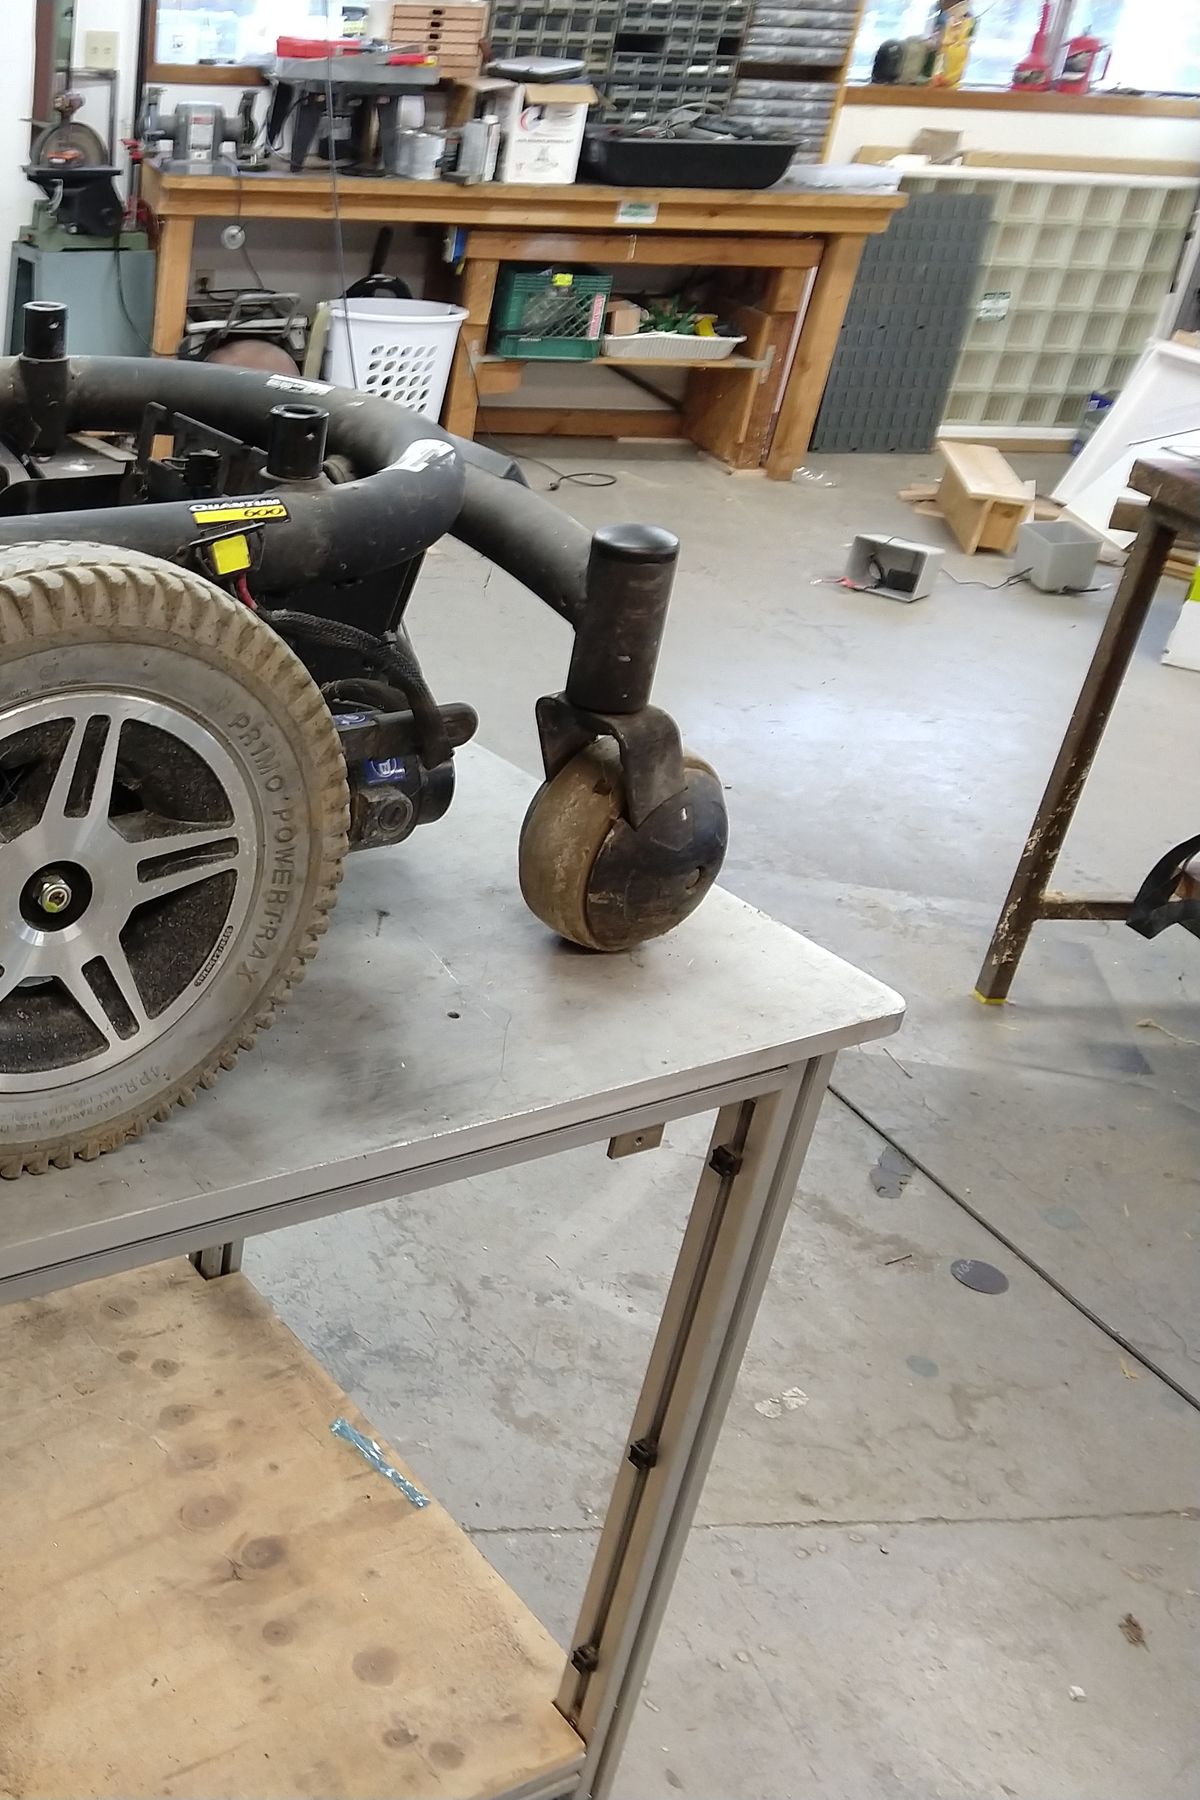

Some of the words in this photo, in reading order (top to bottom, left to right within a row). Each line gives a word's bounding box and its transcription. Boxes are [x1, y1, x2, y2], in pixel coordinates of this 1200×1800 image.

[189, 499, 281, 512] QUANTUM
[244, 508, 284, 517] 600
[228, 712, 284, 792] PRIMO
